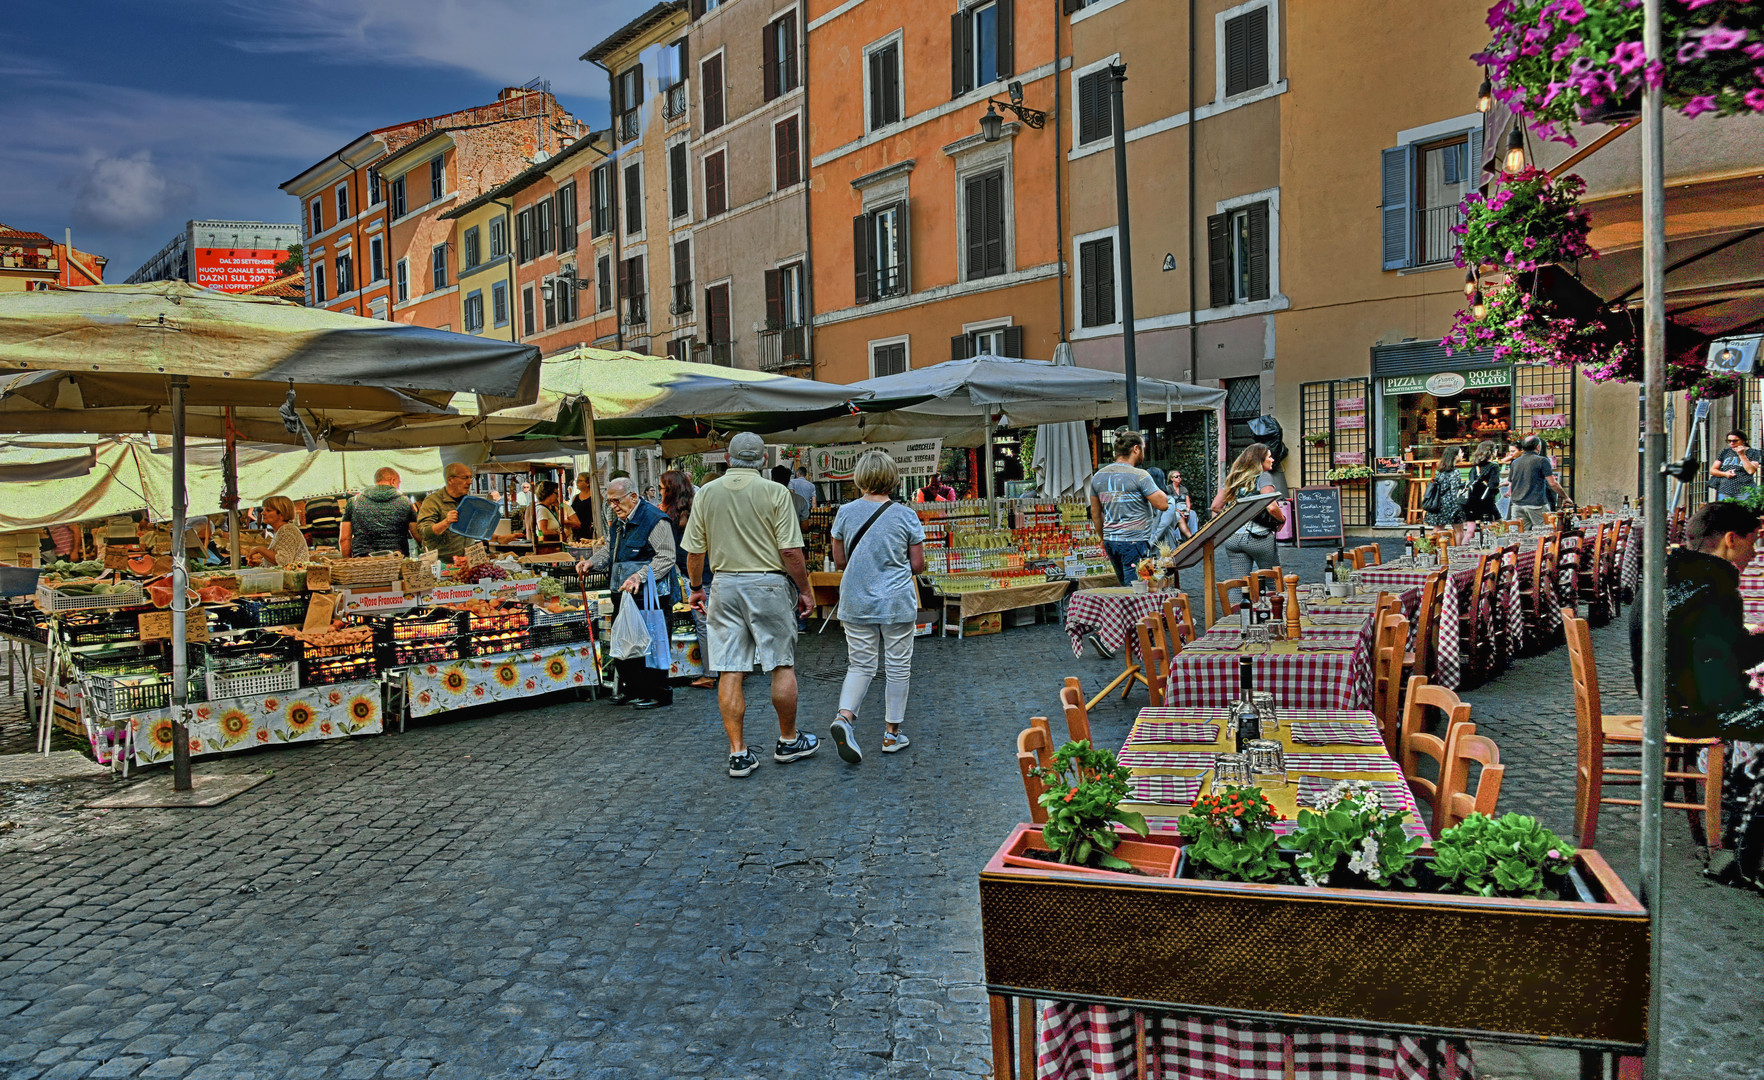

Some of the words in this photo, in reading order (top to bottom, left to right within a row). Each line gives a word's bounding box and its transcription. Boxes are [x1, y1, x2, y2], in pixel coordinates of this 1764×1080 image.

[1469, 369, 1501, 379] DOLCE
[1387, 377, 1417, 388] PIZZA
[1470, 376, 1506, 386] SALATO
[1533, 419, 1562, 428] PIZZA
[450, 589, 473, 599] Francesco
[378, 595, 404, 606] Francesco
